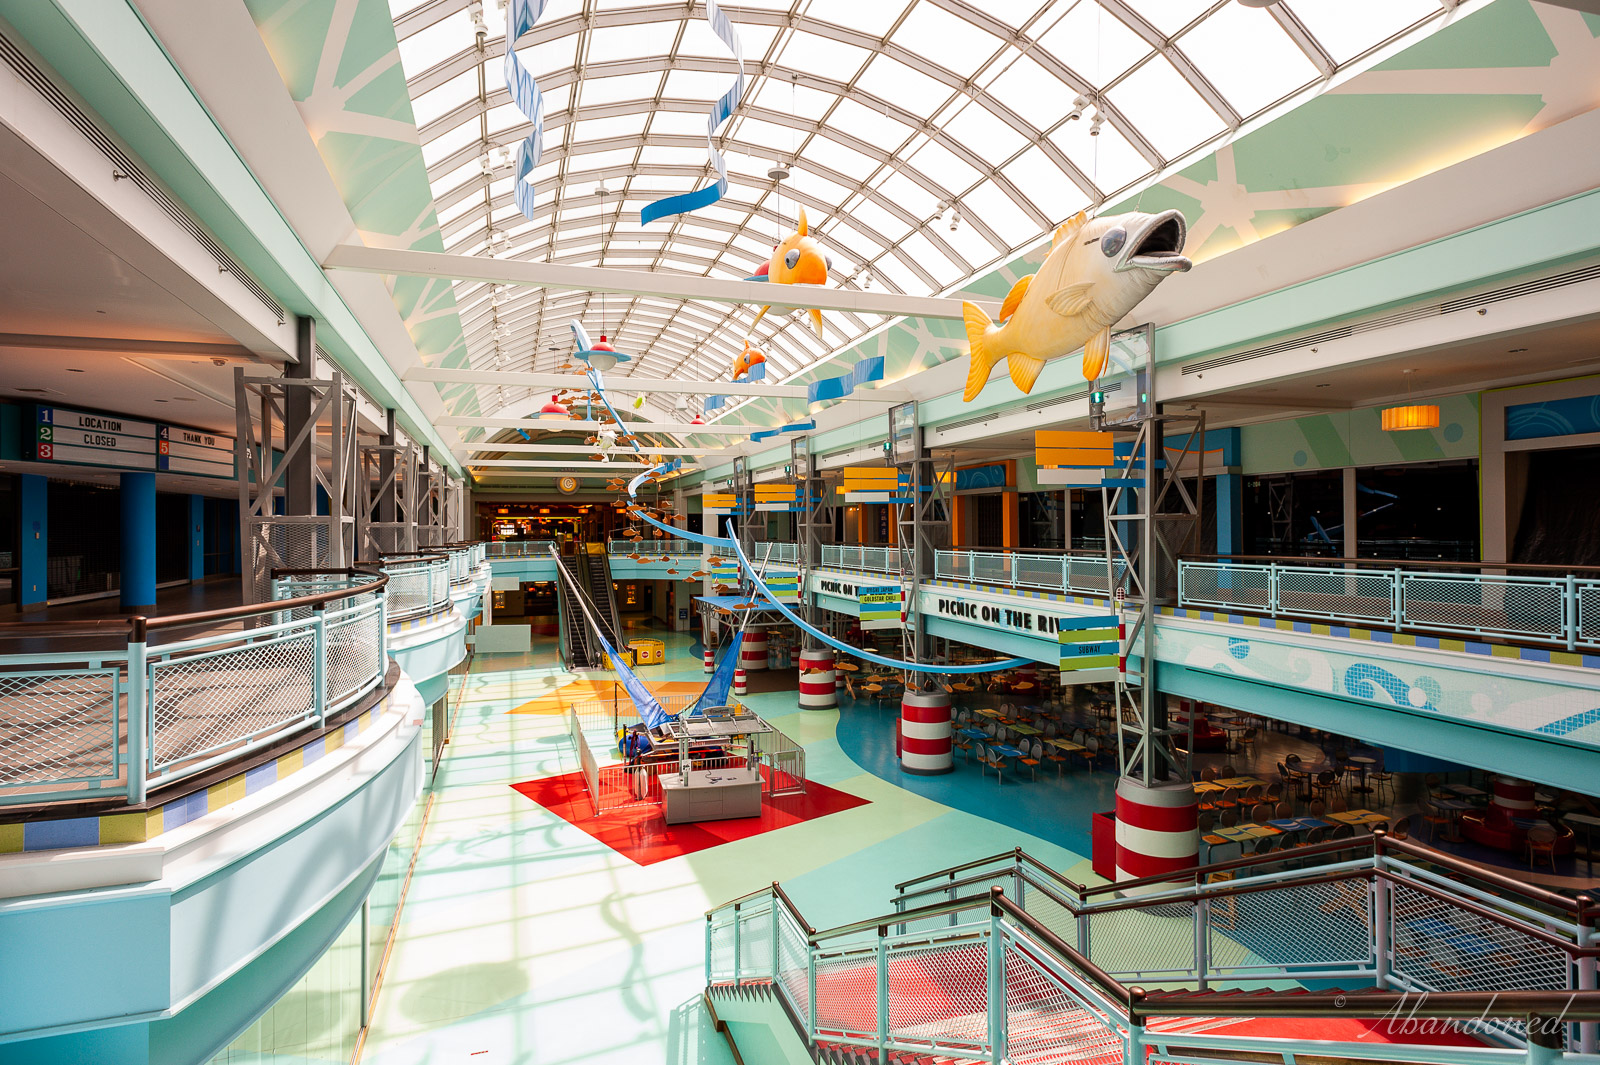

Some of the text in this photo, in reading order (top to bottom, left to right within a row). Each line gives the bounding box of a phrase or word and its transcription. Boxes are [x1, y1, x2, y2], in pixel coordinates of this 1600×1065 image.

[42, 410, 122, 432] 1 LOCATION
[40, 427, 116, 447] 2 CLOSED
[160, 427, 216, 446] 4 THANK YOU
[40, 444, 52, 458] 3
[160, 442, 168, 454] 5
[821, 580, 841, 594] PICNIC
[843, 583, 853, 596] ON
[864, 595, 884, 603] GOLDSTAR
[938, 598, 1060, 635] PICNIC ON THE RIV
[1078, 645, 1101, 654] SUBWAY
